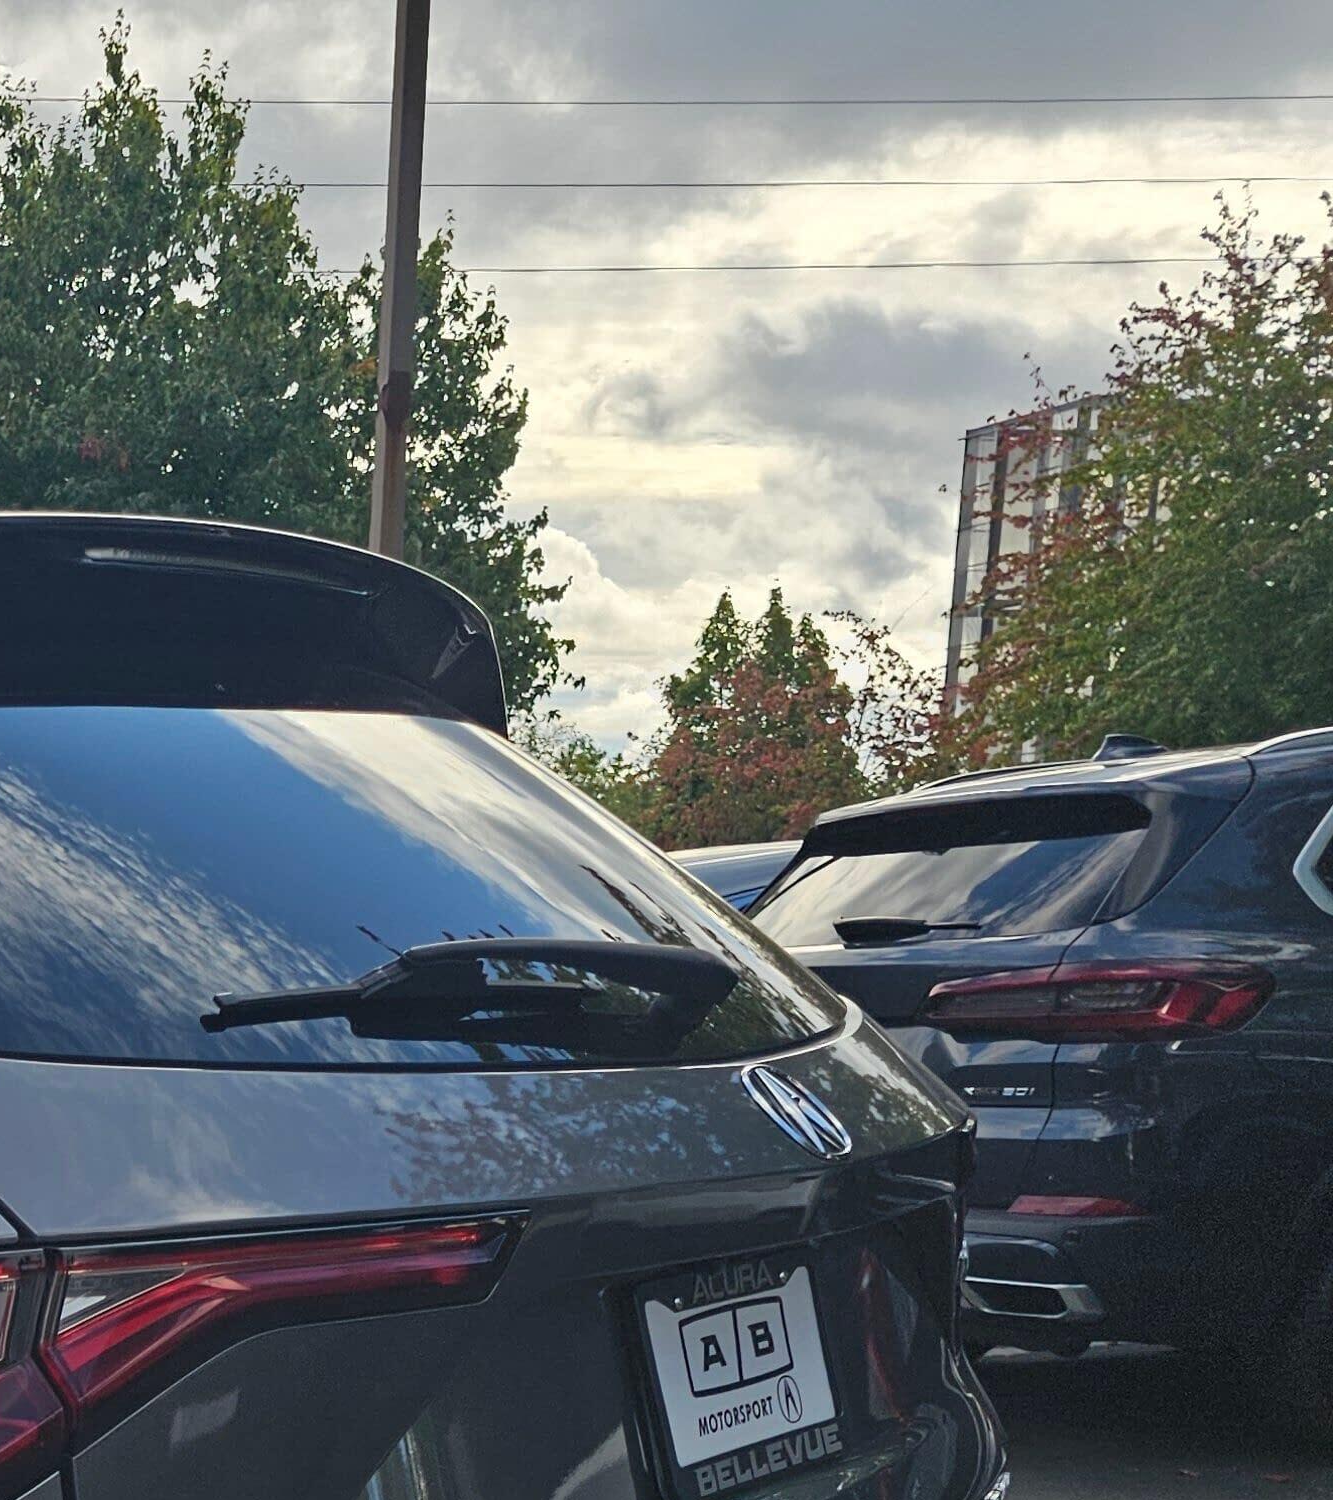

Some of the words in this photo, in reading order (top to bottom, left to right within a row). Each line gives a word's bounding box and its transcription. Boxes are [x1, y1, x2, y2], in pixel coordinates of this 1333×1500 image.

[693, 1260, 773, 1304] ACURA
[700, 1334, 727, 1372] A
[747, 1320, 775, 1357] B
[698, 1396, 773, 1437] MOTORSPORT
[694, 1423, 843, 1497] BELLEVUE
